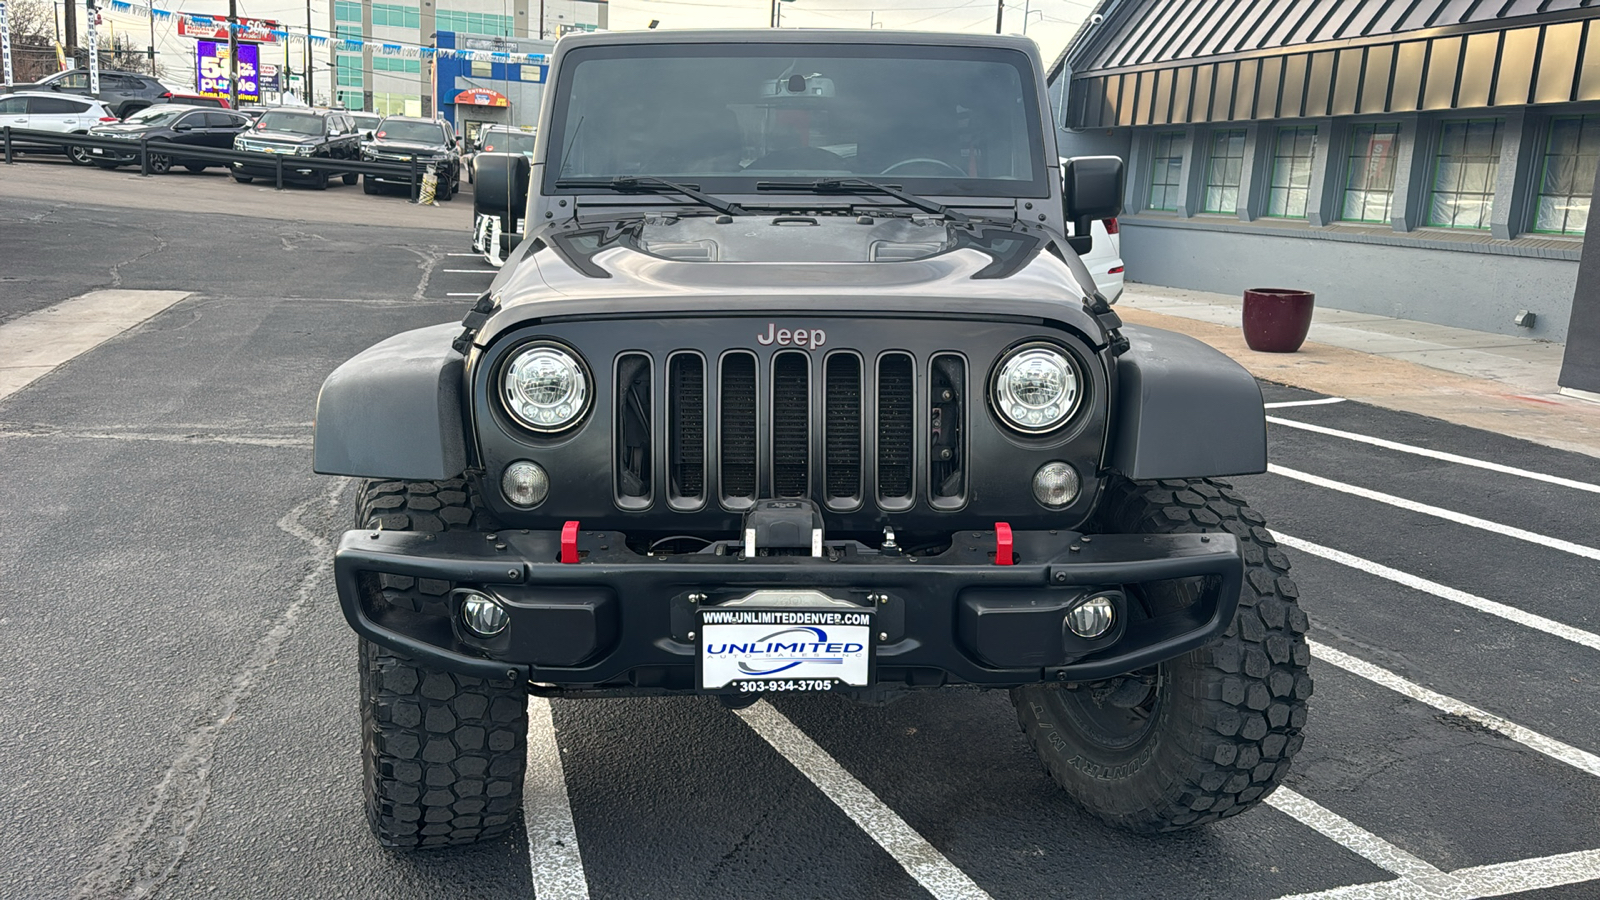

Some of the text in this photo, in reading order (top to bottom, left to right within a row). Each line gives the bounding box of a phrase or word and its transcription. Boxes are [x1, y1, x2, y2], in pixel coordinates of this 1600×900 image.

[88, 18, 98, 91] GREAT DEALS
[201, 79, 256, 91] purle
[467, 88, 497, 97] ENTRANCE
[757, 323, 826, 351] Jeep
[702, 612, 870, 625] WWWUNLIMITEDDENVER.COM
[707, 643, 863, 654] UNLIMITED
[739, 680, 832, 692] 303-934-3705
[1029, 701, 1067, 752] M/T
